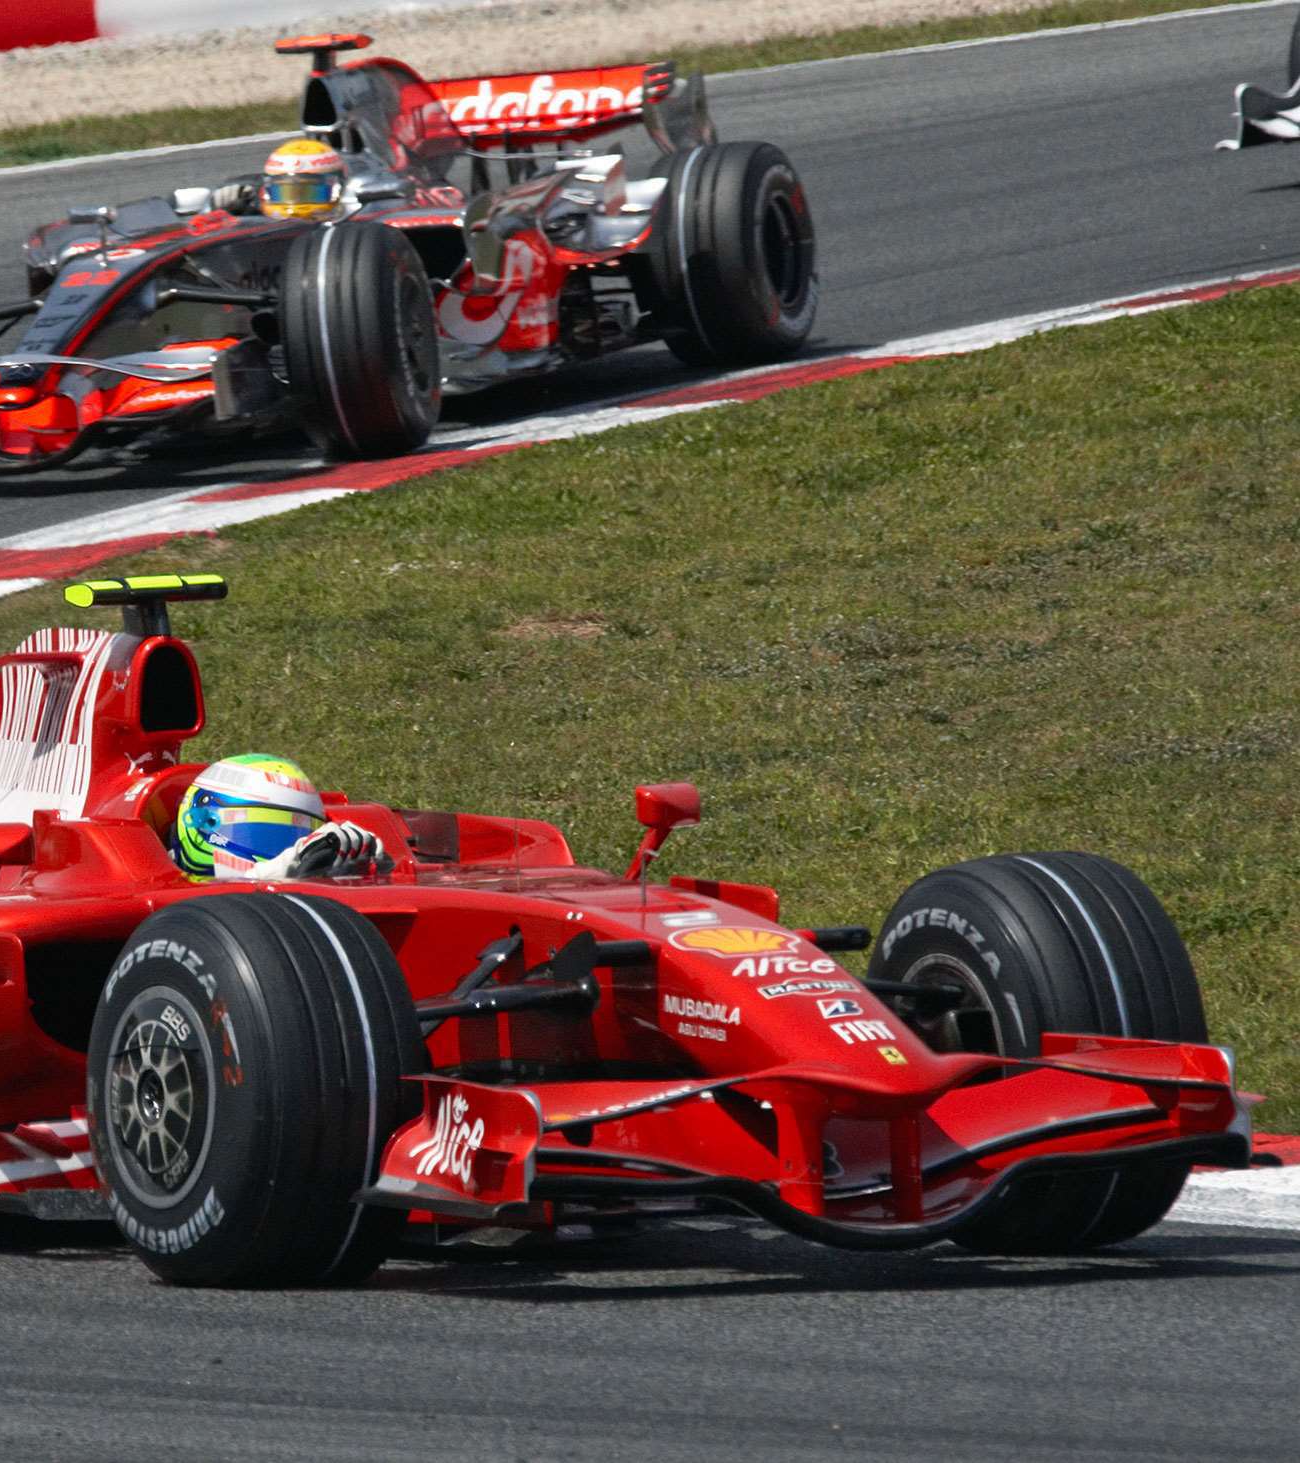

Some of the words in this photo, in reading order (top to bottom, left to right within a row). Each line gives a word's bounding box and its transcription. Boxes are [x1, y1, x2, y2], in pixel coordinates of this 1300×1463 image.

[441, 74, 644, 129] dafon
[882, 907, 1001, 980] POTENZA
[105, 939, 218, 1004] POTENZA
[160, 1005, 191, 1042] BBS
[664, 994, 741, 1025] MUBADALA
[830, 1020, 896, 1044] FIAT
[108, 1185, 226, 1255] BRIDGESTONE
